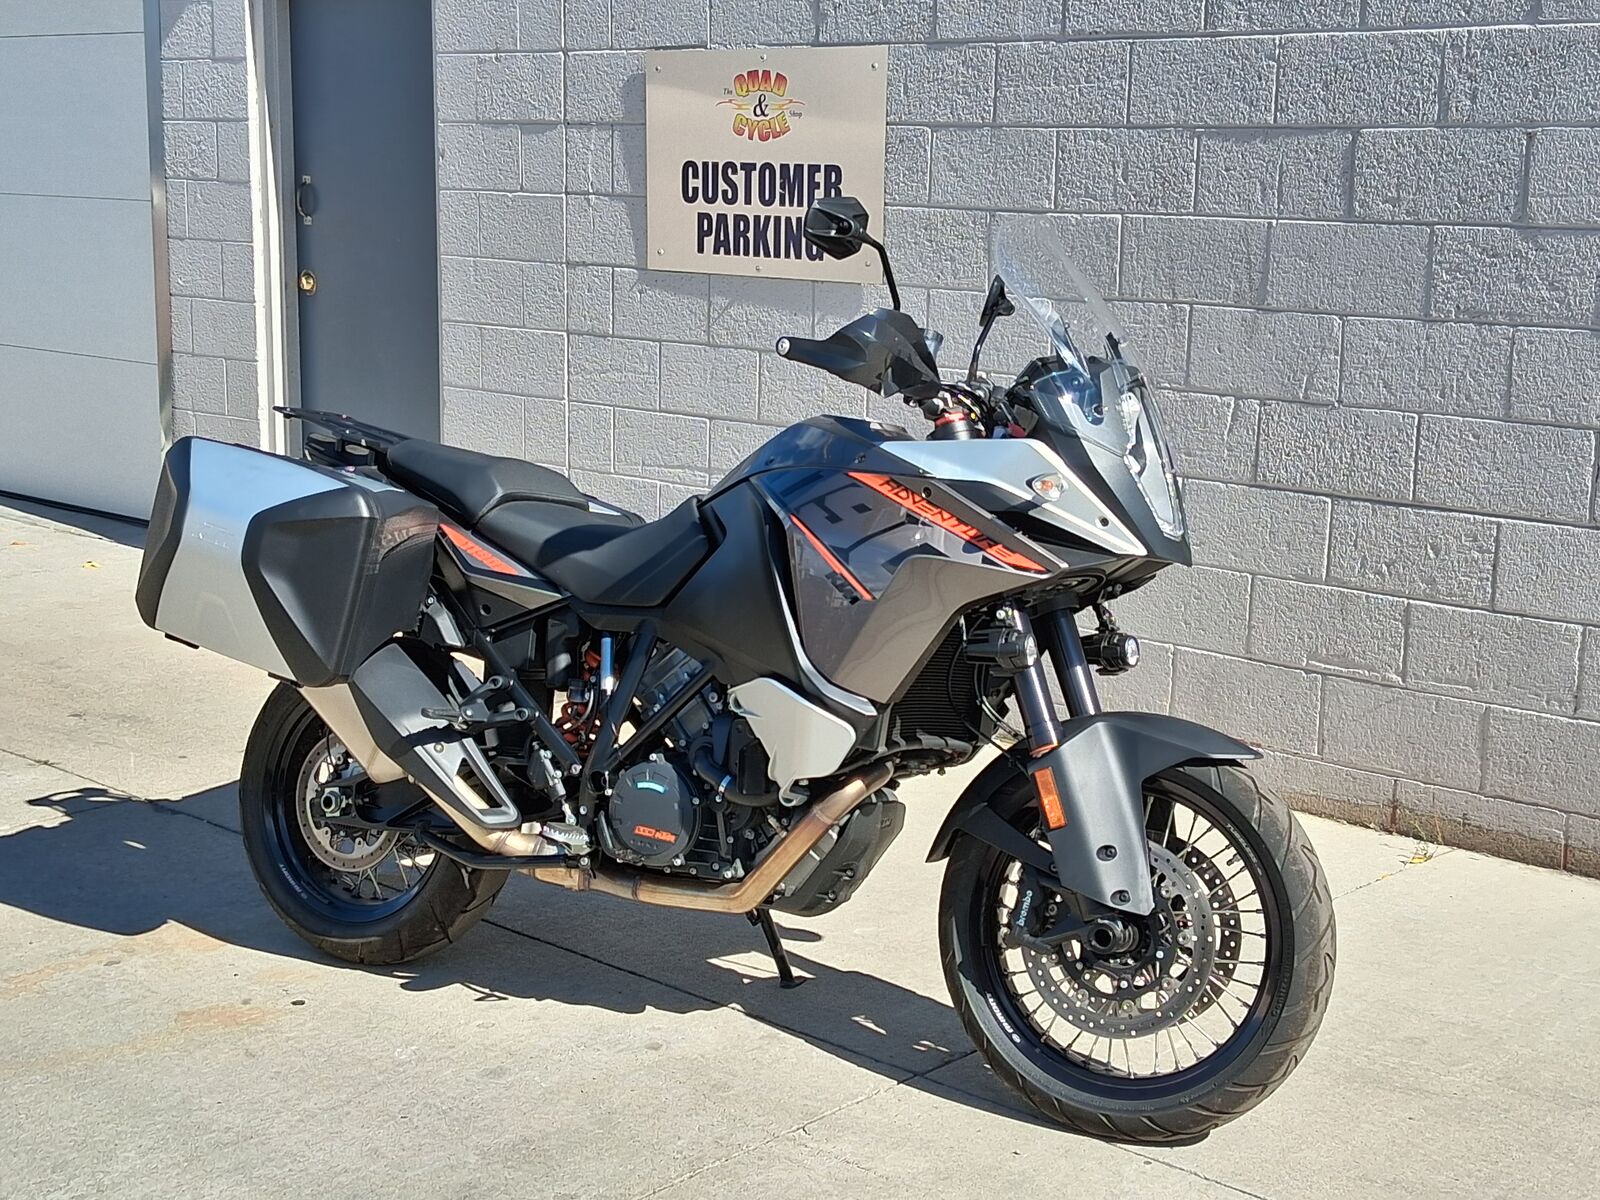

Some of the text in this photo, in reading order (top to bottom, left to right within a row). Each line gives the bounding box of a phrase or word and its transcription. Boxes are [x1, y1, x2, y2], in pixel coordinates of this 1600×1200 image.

[733, 69, 788, 98] QUAD
[752, 93, 770, 118] &
[732, 111, 791, 142] CYCLE
[681, 160, 842, 208] CUSTOMER
[878, 479, 1013, 559] ADVENTURE
